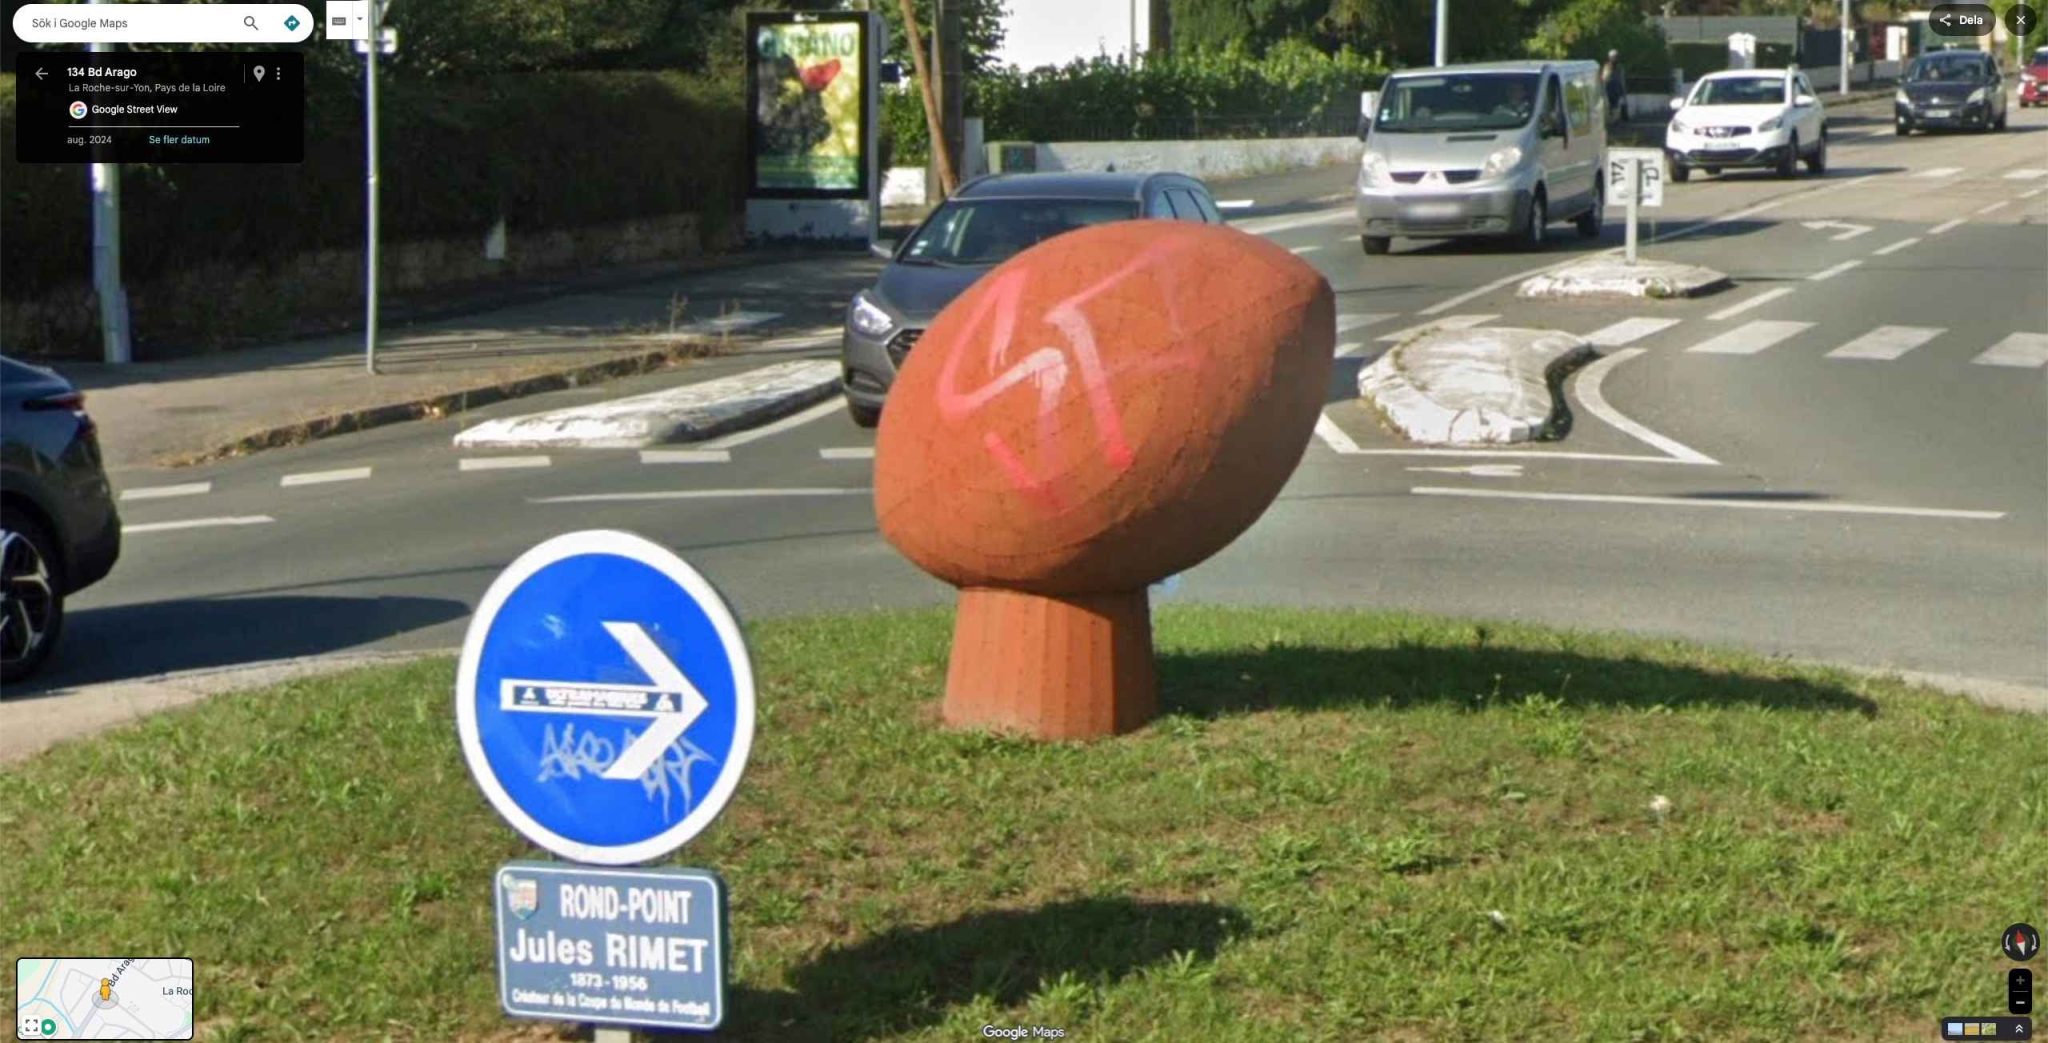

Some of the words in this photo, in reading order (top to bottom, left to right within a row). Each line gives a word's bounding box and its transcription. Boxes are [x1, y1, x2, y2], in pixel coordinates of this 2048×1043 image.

[559, 884, 692, 925] ROND-POINT
[510, 928, 594, 967] Jules
[605, 932, 709, 974] RIMET
[566, 992, 577, 1007] la
